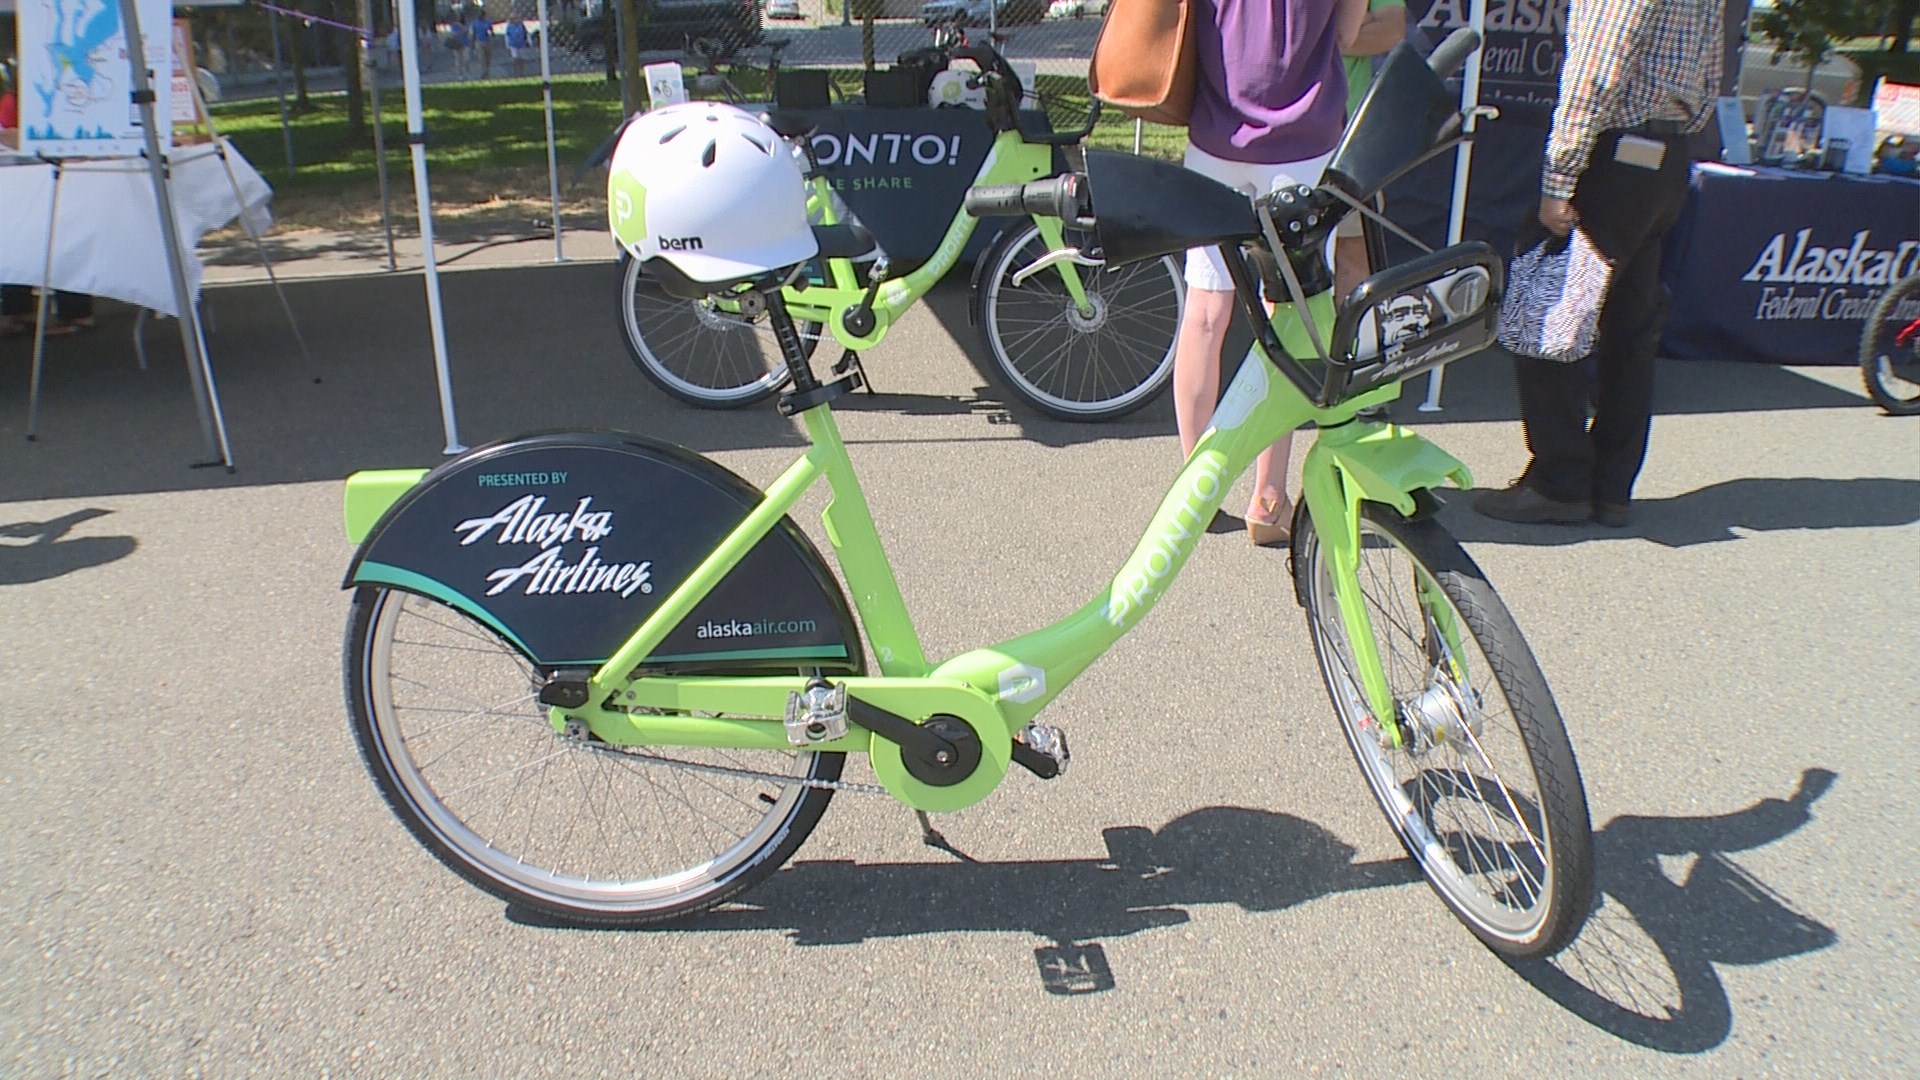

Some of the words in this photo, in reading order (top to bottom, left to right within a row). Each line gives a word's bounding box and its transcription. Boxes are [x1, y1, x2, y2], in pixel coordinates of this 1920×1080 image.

[811, 133, 961, 166] ONTO!
[852, 176, 913, 191] SHARE
[658, 235, 704, 251] bern
[927, 211, 974, 276] PRONT
[1756, 286, 1826, 320] Federal
[478, 472, 549, 488] PRESENTED
[551, 471, 568, 484] BY
[454, 493, 613, 550] Alaska
[1100, 451, 1228, 628] PRONTO!
[697, 618, 816, 639] alaskaair.com
